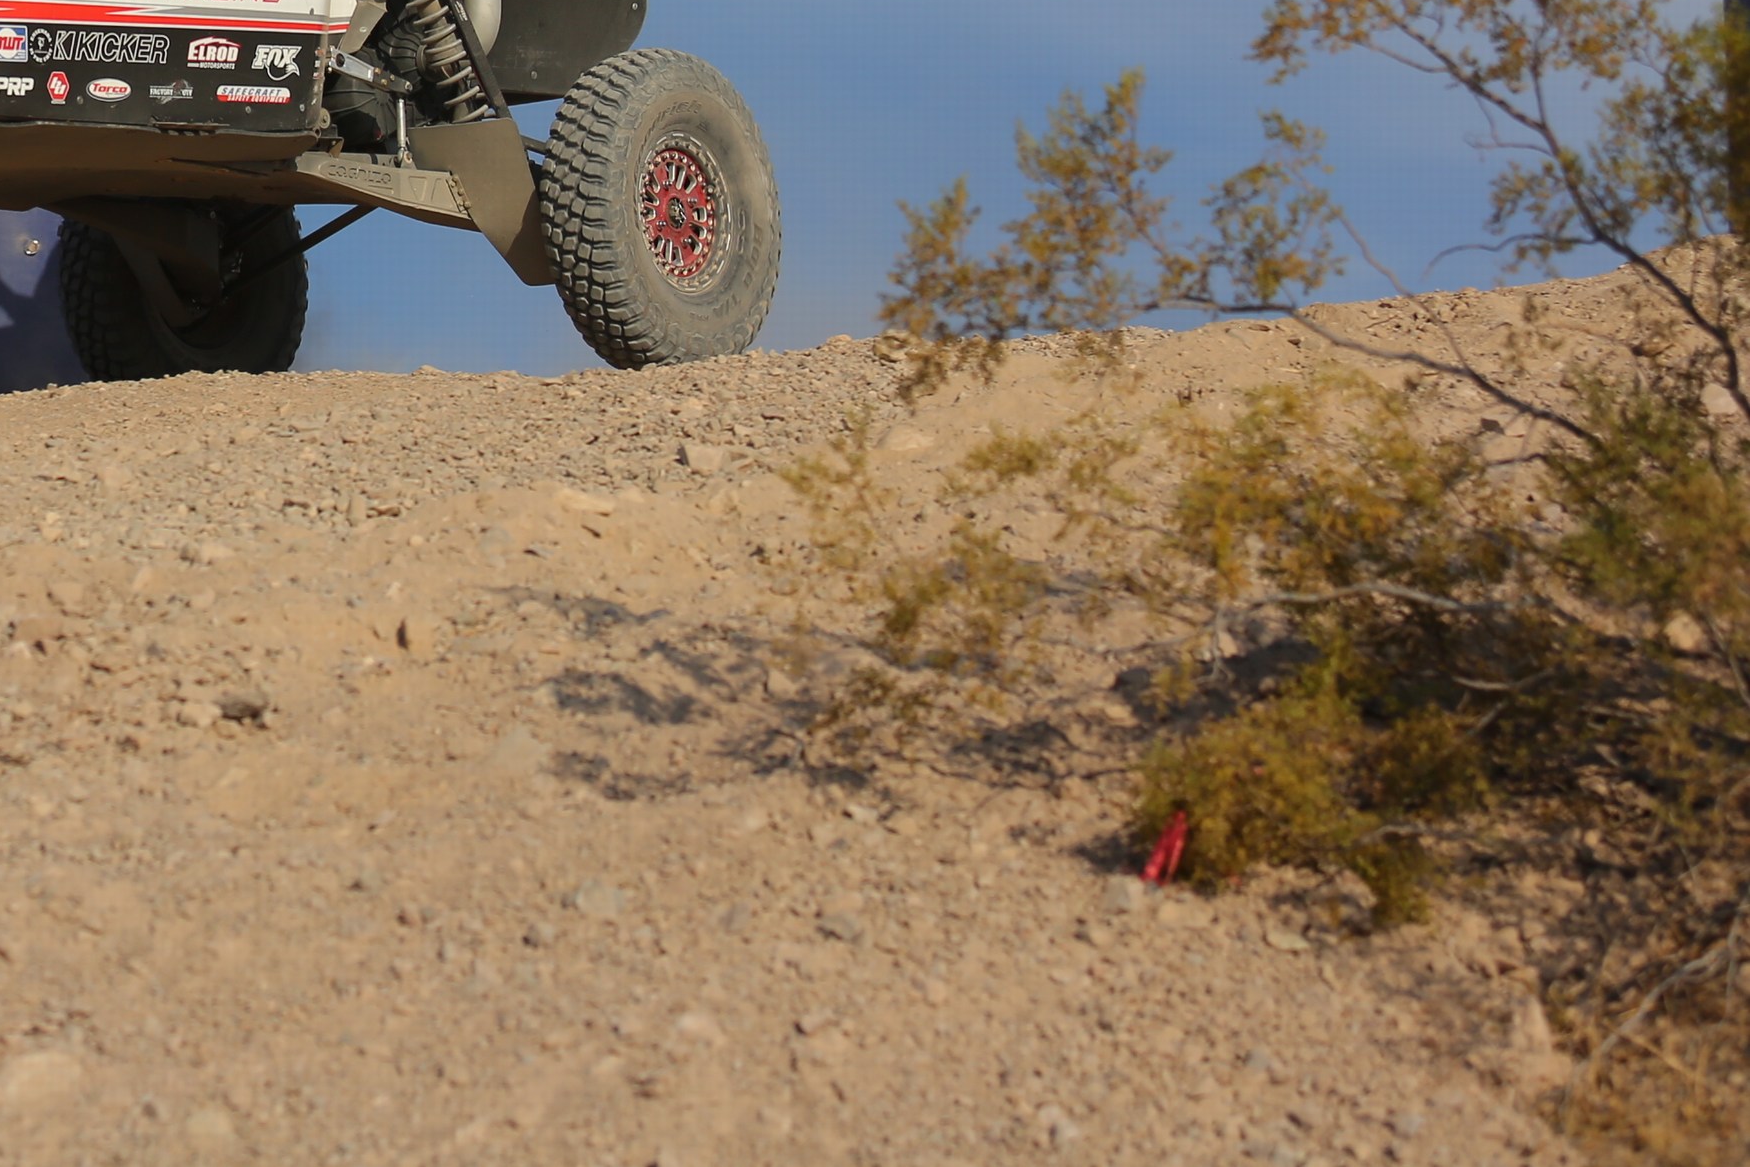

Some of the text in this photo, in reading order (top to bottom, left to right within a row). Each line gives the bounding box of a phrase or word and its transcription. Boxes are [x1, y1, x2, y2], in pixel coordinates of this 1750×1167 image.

[75, 31, 170, 64] KICKER
[187, 37, 240, 62] ELROD
[251, 44, 302, 71] FOX
[199, 62, 236, 70] MOTORSPORTS
[92, 83, 128, 93] Torco
[221, 87, 282, 96] SAFECRAFT
[227, 95, 288, 104] SAFETY EQUIPMENT
